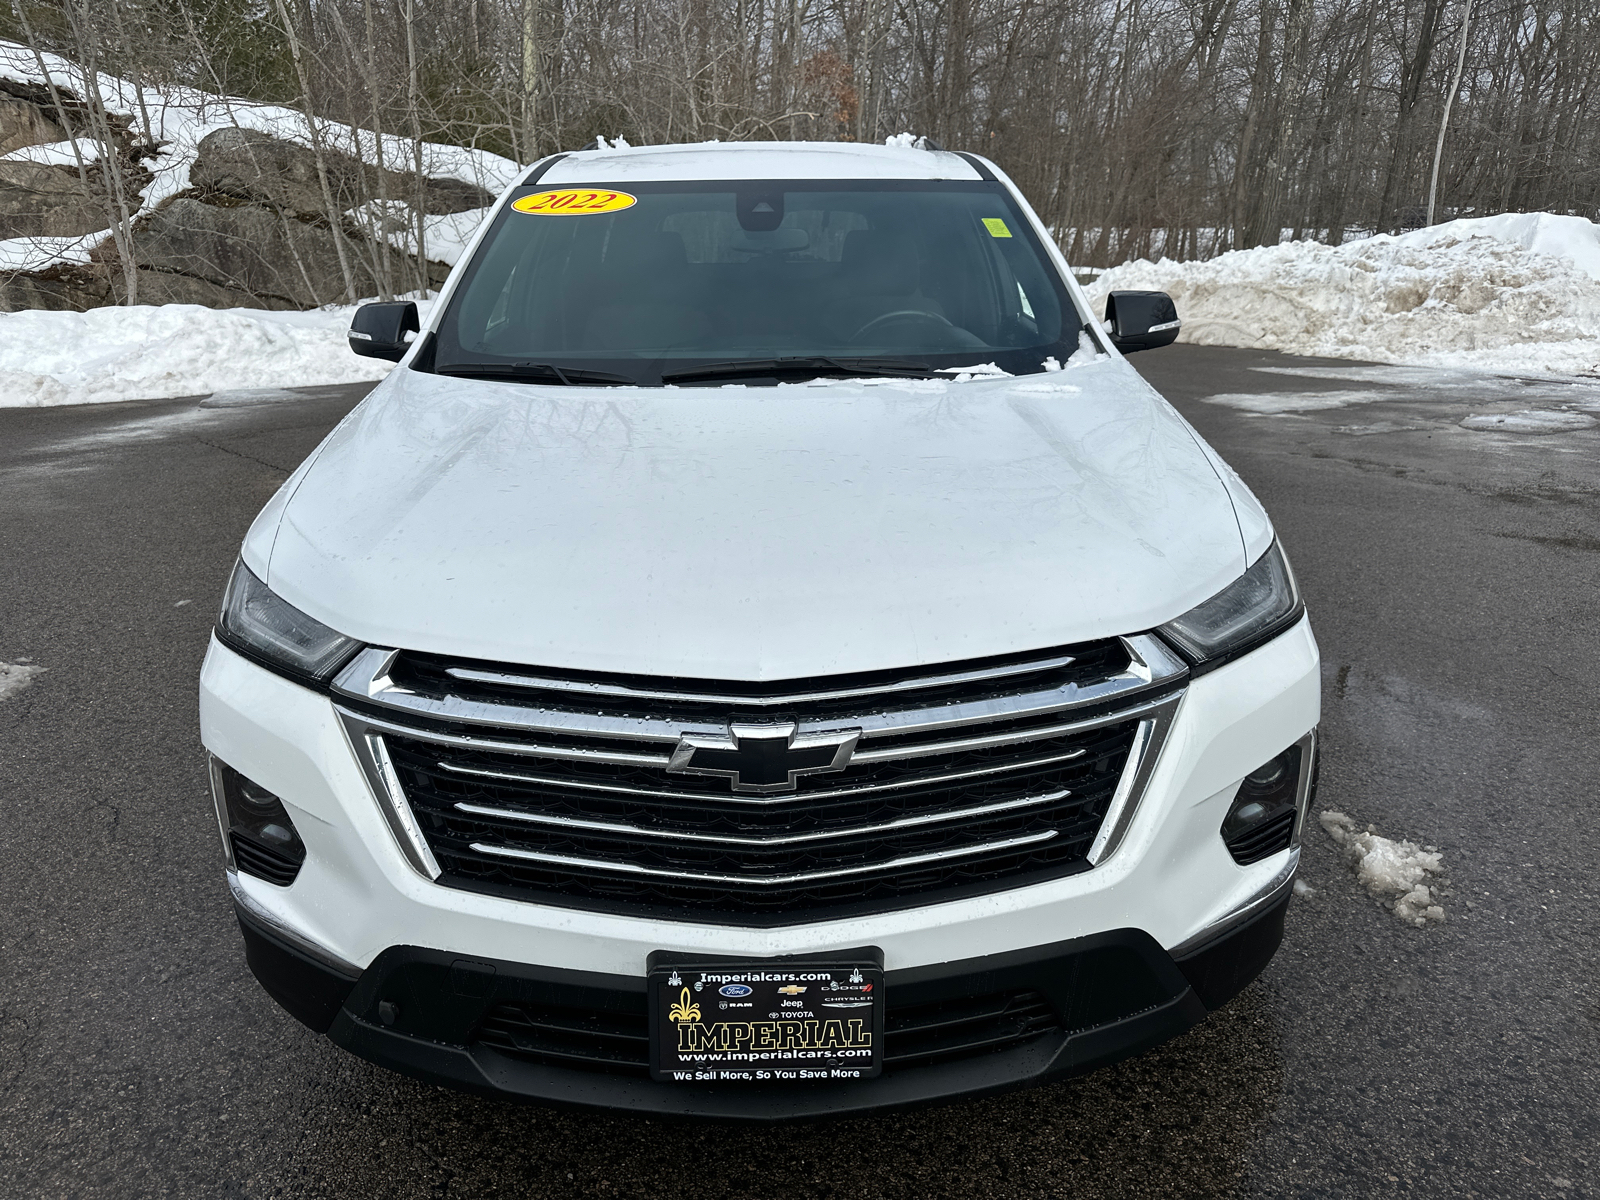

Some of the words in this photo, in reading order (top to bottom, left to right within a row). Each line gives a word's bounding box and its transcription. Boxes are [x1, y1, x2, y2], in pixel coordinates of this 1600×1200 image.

[527, 193, 617, 210] 2022
[700, 972, 831, 984] Imperialcars.com
[725, 986, 745, 995] Ford
[821, 984, 869, 992] DDGE
[780, 1000, 803, 1008] Jeep
[677, 1019, 871, 1051] IMPERIAL
[678, 1049, 871, 1061] www.imperialcars.com
[673, 1072, 692, 1080] We
[695, 1071, 716, 1080] Sell
[720, 1071, 753, 1080] More,
[756, 1070, 771, 1079] So
[775, 1070, 796, 1079] You
[799, 1069, 828, 1079] Save
[831, 1069, 860, 1078] More
